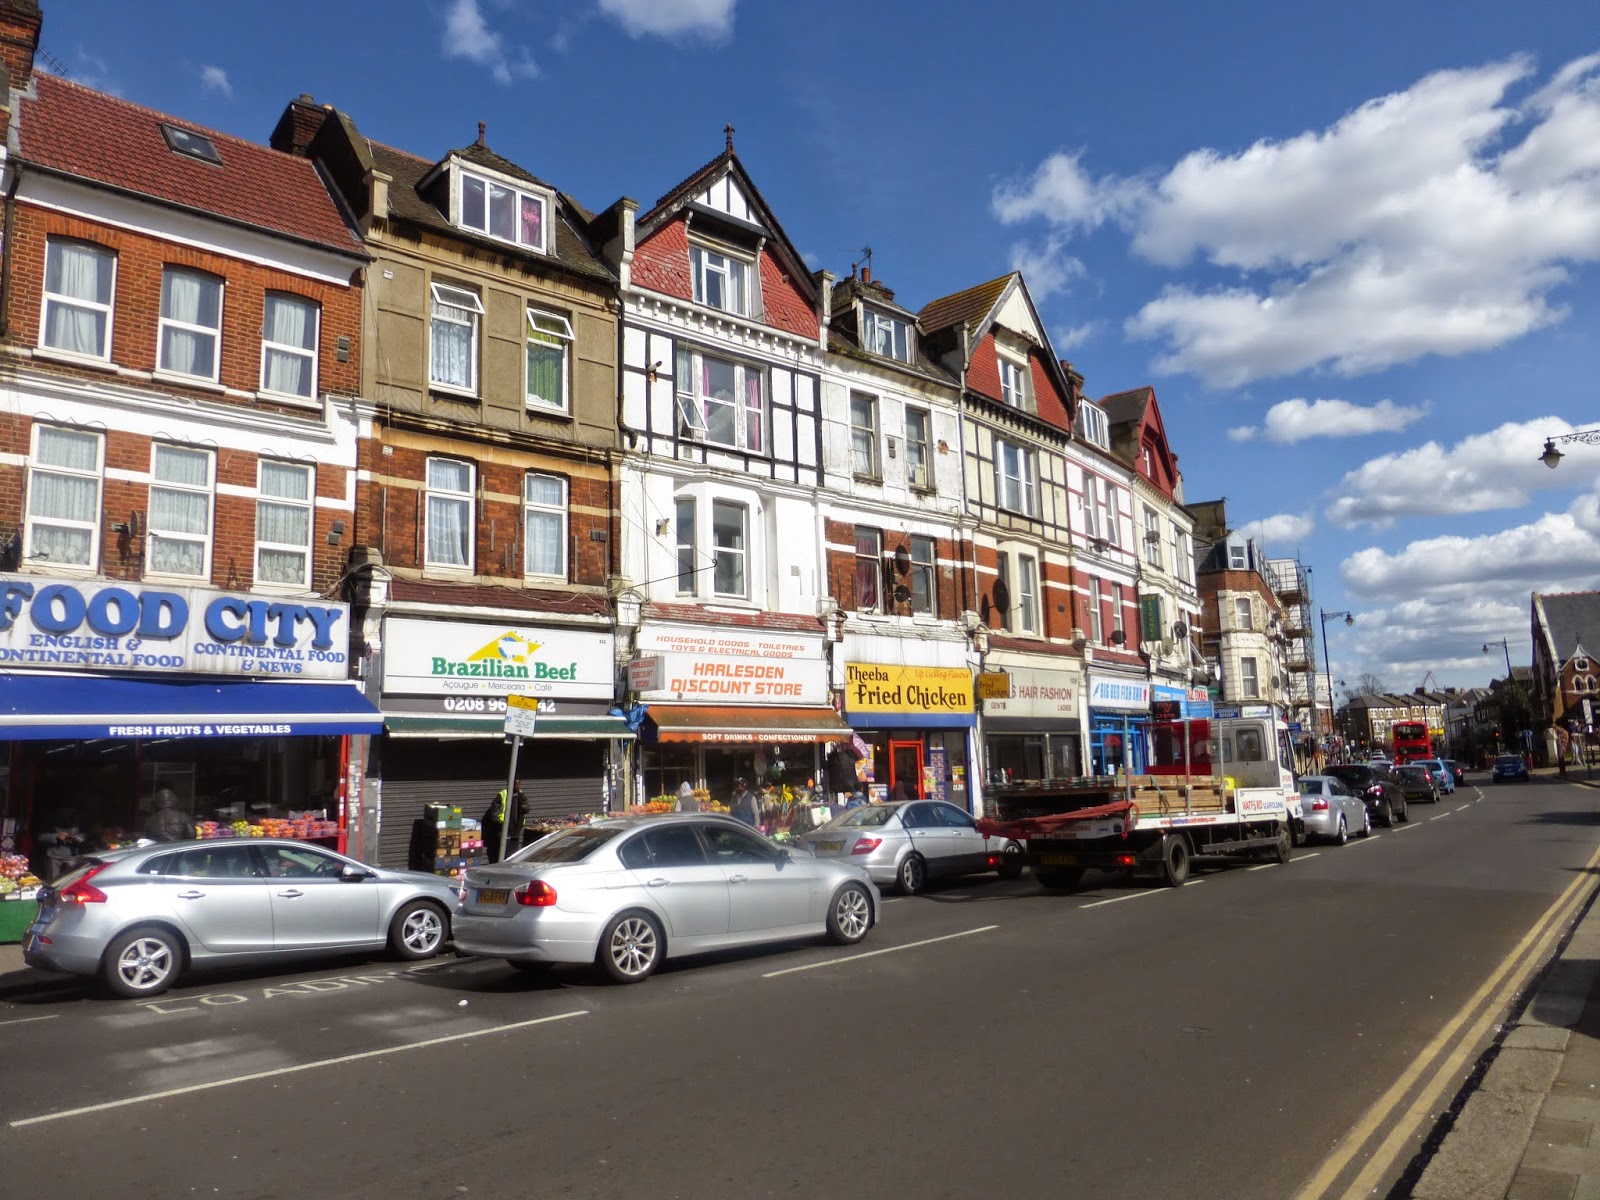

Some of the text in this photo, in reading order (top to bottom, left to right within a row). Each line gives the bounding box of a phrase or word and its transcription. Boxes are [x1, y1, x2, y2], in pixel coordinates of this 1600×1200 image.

[0, 581, 343, 650] FOOD CITY
[30, 634, 142, 650] ENGLISH &
[656, 635, 716, 646] HOUSEHOLD
[717, 640, 750, 648] GOODS
[758, 642, 805, 651] TOILETRIES
[0, 647, 184, 668] ONTINENTAL FOOD
[194, 642, 346, 663] CONTINENTAL FOOD
[670, 644, 696, 652] TOYS
[708, 647, 761, 656] ELECTRICAL
[763, 650, 793, 658] GOODS
[241, 660, 302, 674] & NEWS
[431, 656, 578, 680] Brazilian Beef
[693, 662, 785, 679] HARLESDEN
[847, 665, 889, 684] Theeba
[442, 680, 553, 692] Açougue Mercearia Café
[670, 678, 803, 696] DISCOUNT STORE
[1019, 685, 1038, 699] HAIR
[1040, 687, 1072, 701] FASHION
[444, 696, 485, 711] 0208
[487, 697, 507, 711] 96
[537, 699, 556, 713] 42
[853, 684, 967, 710] Fried Chicken
[1057, 704, 1072, 712] LADIES
[109, 724, 291, 736] FRESH FRUITS & VEGETABLES
